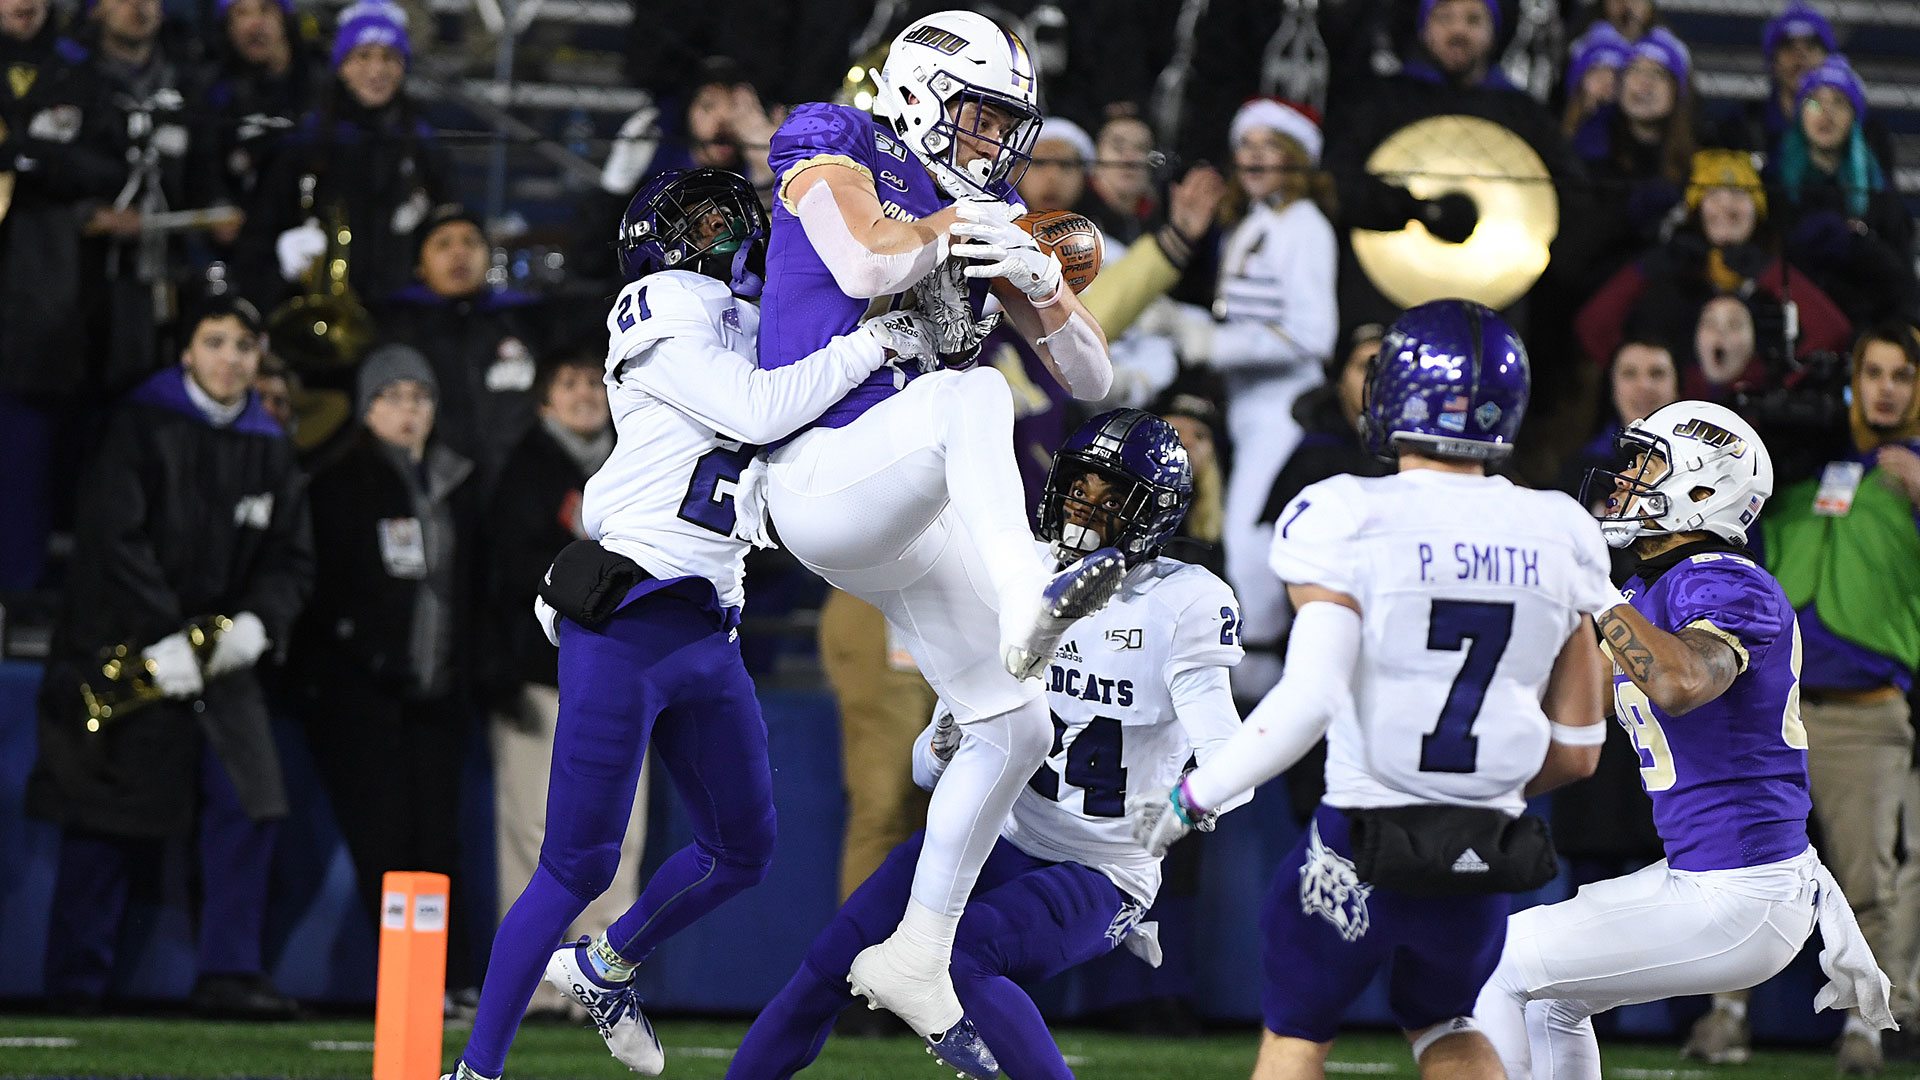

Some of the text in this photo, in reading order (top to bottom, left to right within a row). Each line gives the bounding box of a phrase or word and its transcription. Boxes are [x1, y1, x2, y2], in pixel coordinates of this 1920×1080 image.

[903, 25, 970, 56] JMU
[880, 170, 904, 188] CAA
[617, 285, 652, 333] 21
[884, 321, 920, 338] adidas
[1090, 446, 1112, 459] WSU
[1418, 542, 1540, 586] P. SMITH
[1046, 665, 1134, 707] DCATS
[1419, 598, 1515, 774] 7
